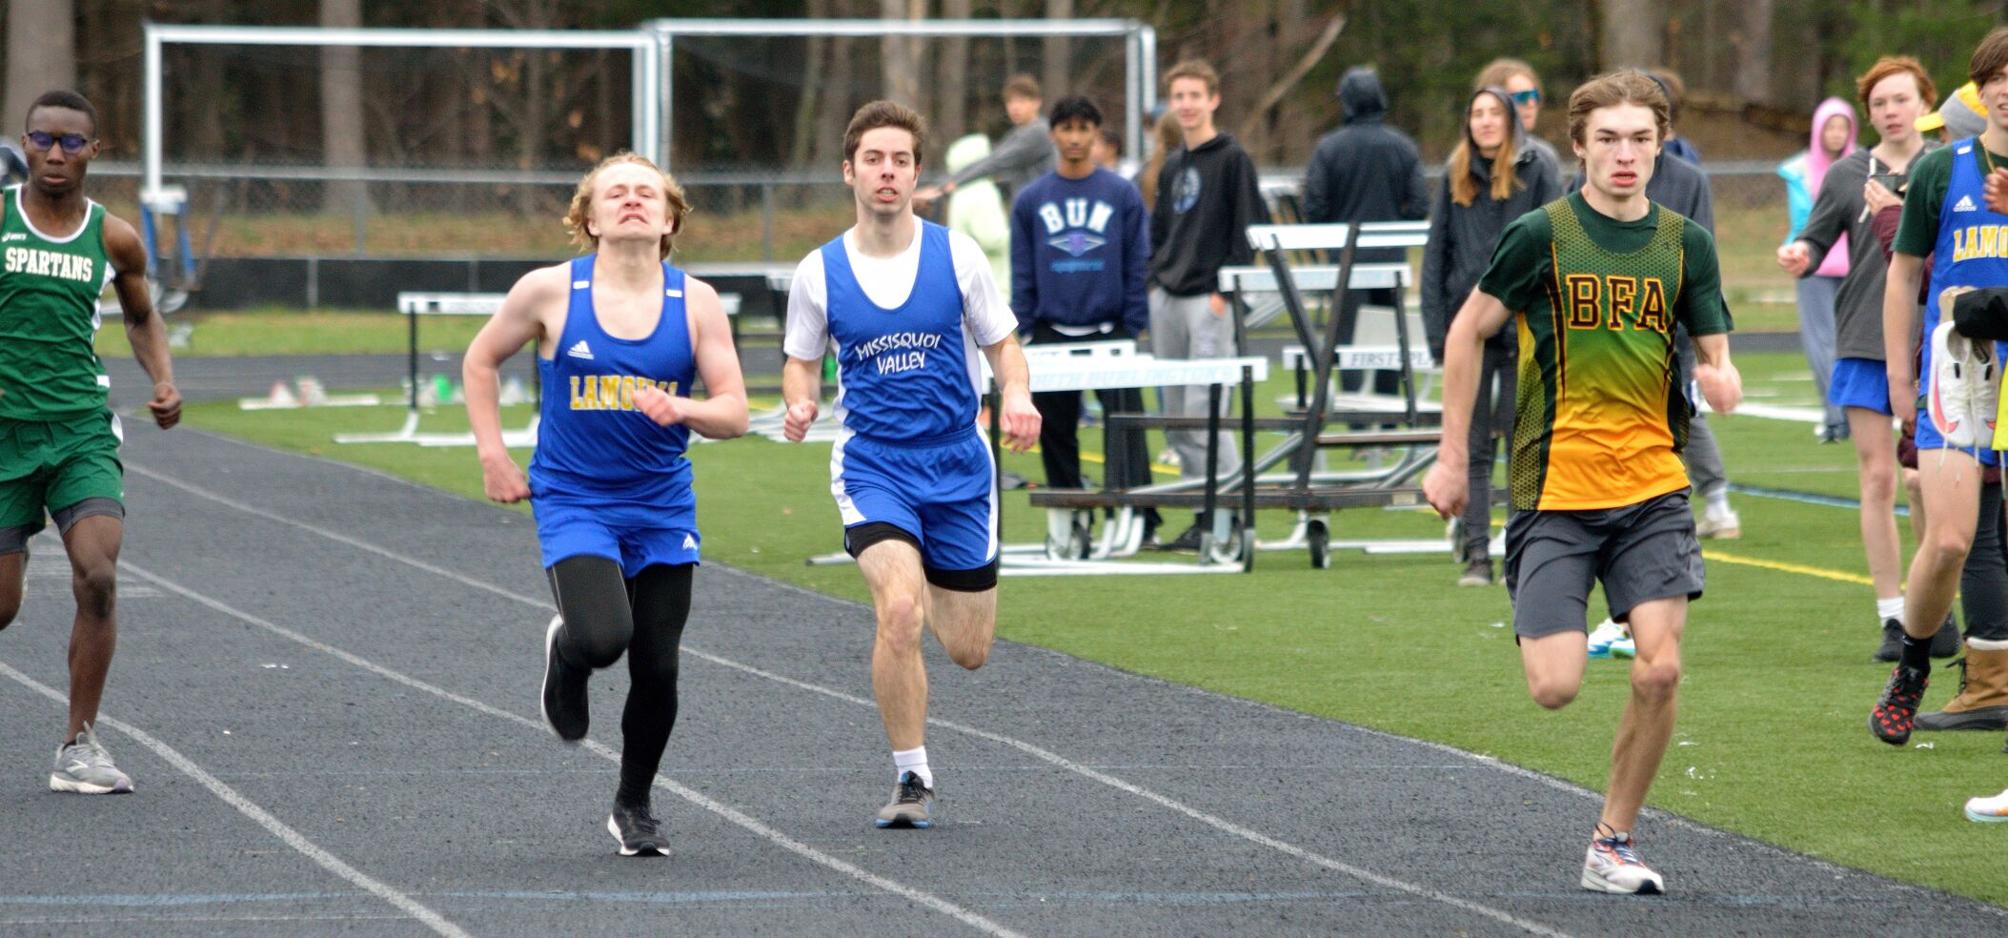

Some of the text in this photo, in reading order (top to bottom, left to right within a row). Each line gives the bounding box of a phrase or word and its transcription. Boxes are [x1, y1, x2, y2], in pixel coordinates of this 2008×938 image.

[5, 246, 93, 282] SPARTANS
[1565, 273, 1668, 334] BFA
[855, 331, 942, 361] MISSISQUOI
[876, 351, 926, 376] VALLEY
